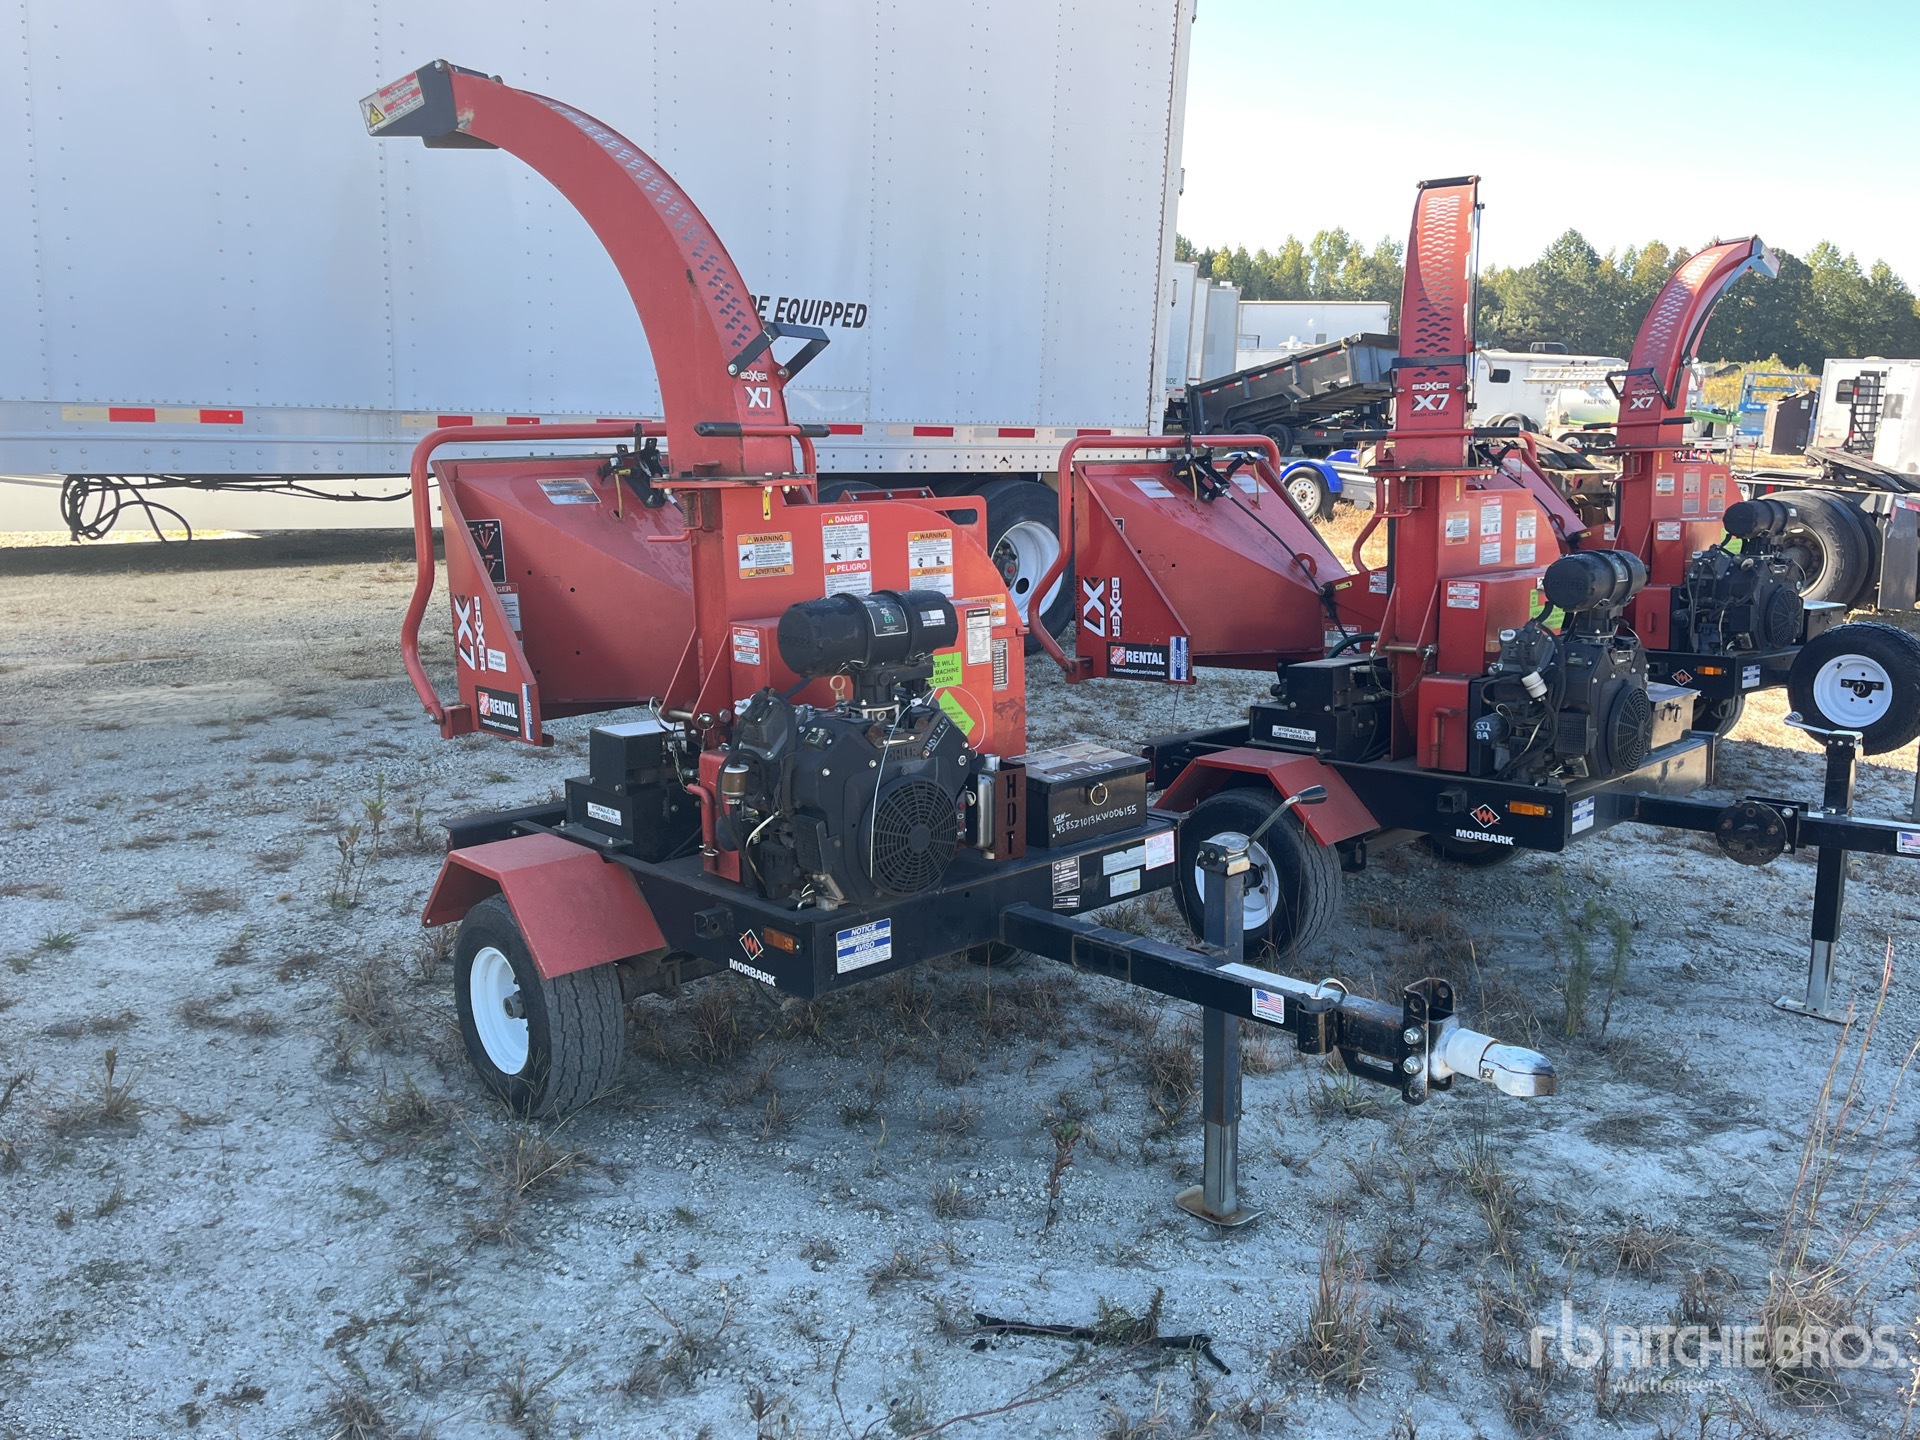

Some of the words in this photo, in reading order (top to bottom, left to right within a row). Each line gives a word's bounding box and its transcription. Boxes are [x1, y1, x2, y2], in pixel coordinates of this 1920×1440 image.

[774, 297, 867, 328] EQUIPPED
[740, 370, 768, 382] BOXER
[1412, 382, 1450, 391] BOXER
[744, 386, 771, 409] X7
[1413, 394, 1449, 411] X7
[1630, 397, 1655, 410] X7
[835, 515, 864, 523] DANGER
[753, 534, 784, 542] WARNING
[836, 563, 867, 572] PELIGRO
[1083, 577, 1106, 637] X7
[1109, 577, 1122, 637] BOXER
[454, 595, 476, 671] X7
[473, 596, 487, 672] BOXER
[1126, 650, 1165, 666] RENTAL
[935, 667, 960, 675] MACHINE
[935, 676, 954, 684] CLEAN
[490, 698, 518, 718] RENTAL
[1006, 774, 1017, 854] HOT
[1456, 829, 1514, 845] MORBARK
[851, 924, 876, 936] NOTICE
[855, 941, 875, 952] AVISO
[729, 958, 776, 987] MORBARK
